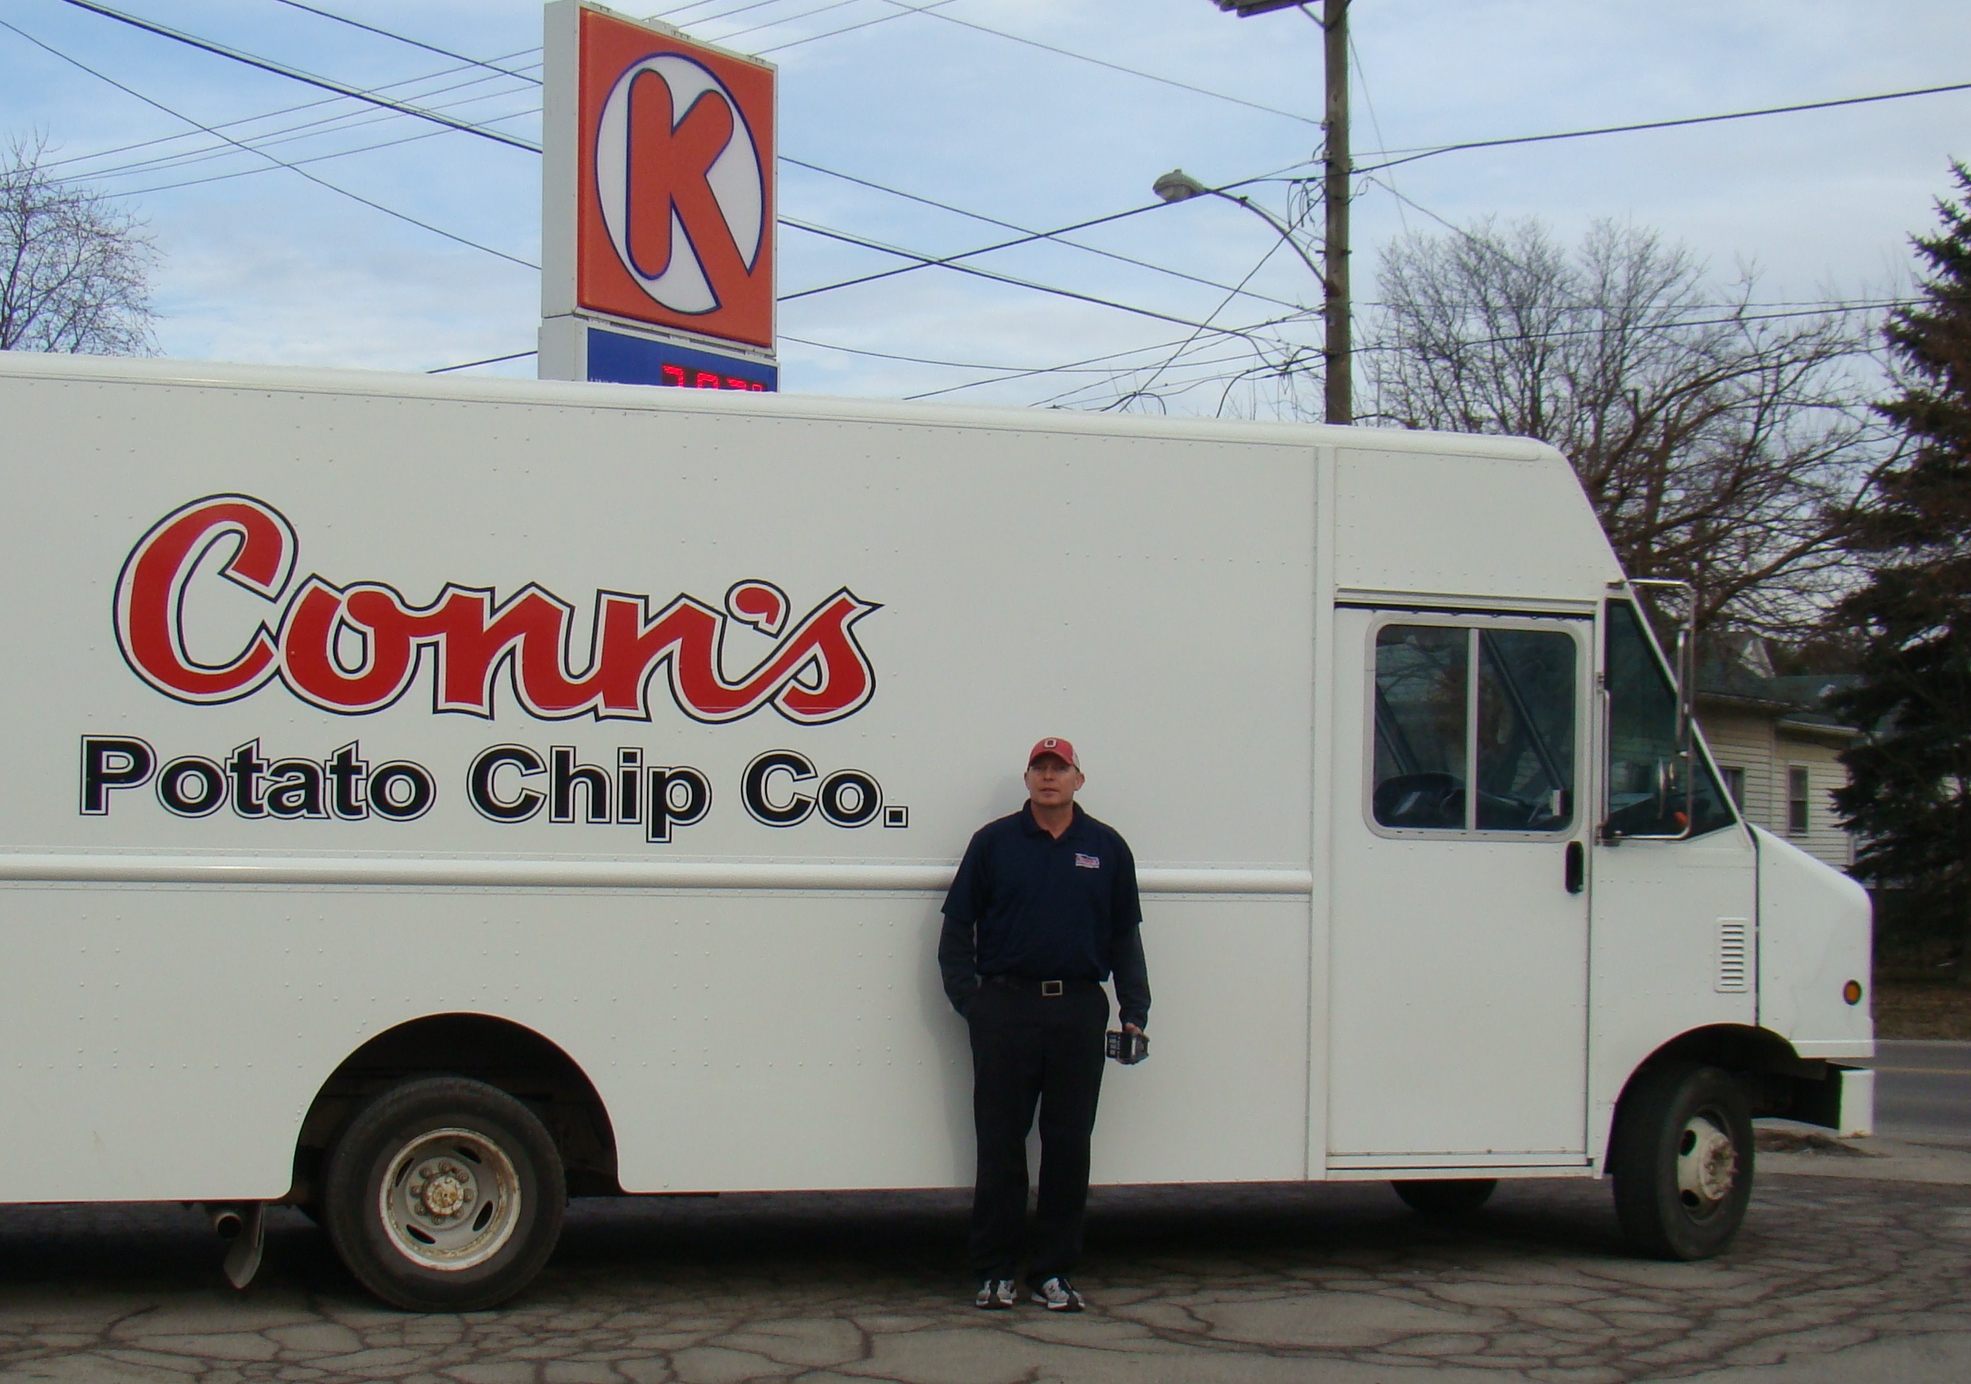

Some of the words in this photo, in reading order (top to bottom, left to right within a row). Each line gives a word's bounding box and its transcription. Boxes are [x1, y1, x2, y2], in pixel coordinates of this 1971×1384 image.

[112, 492, 885, 727] Conn's
[79, 734, 437, 822] Potato
[466, 743, 713, 844] Chip
[740, 749, 910, 829] Co.
